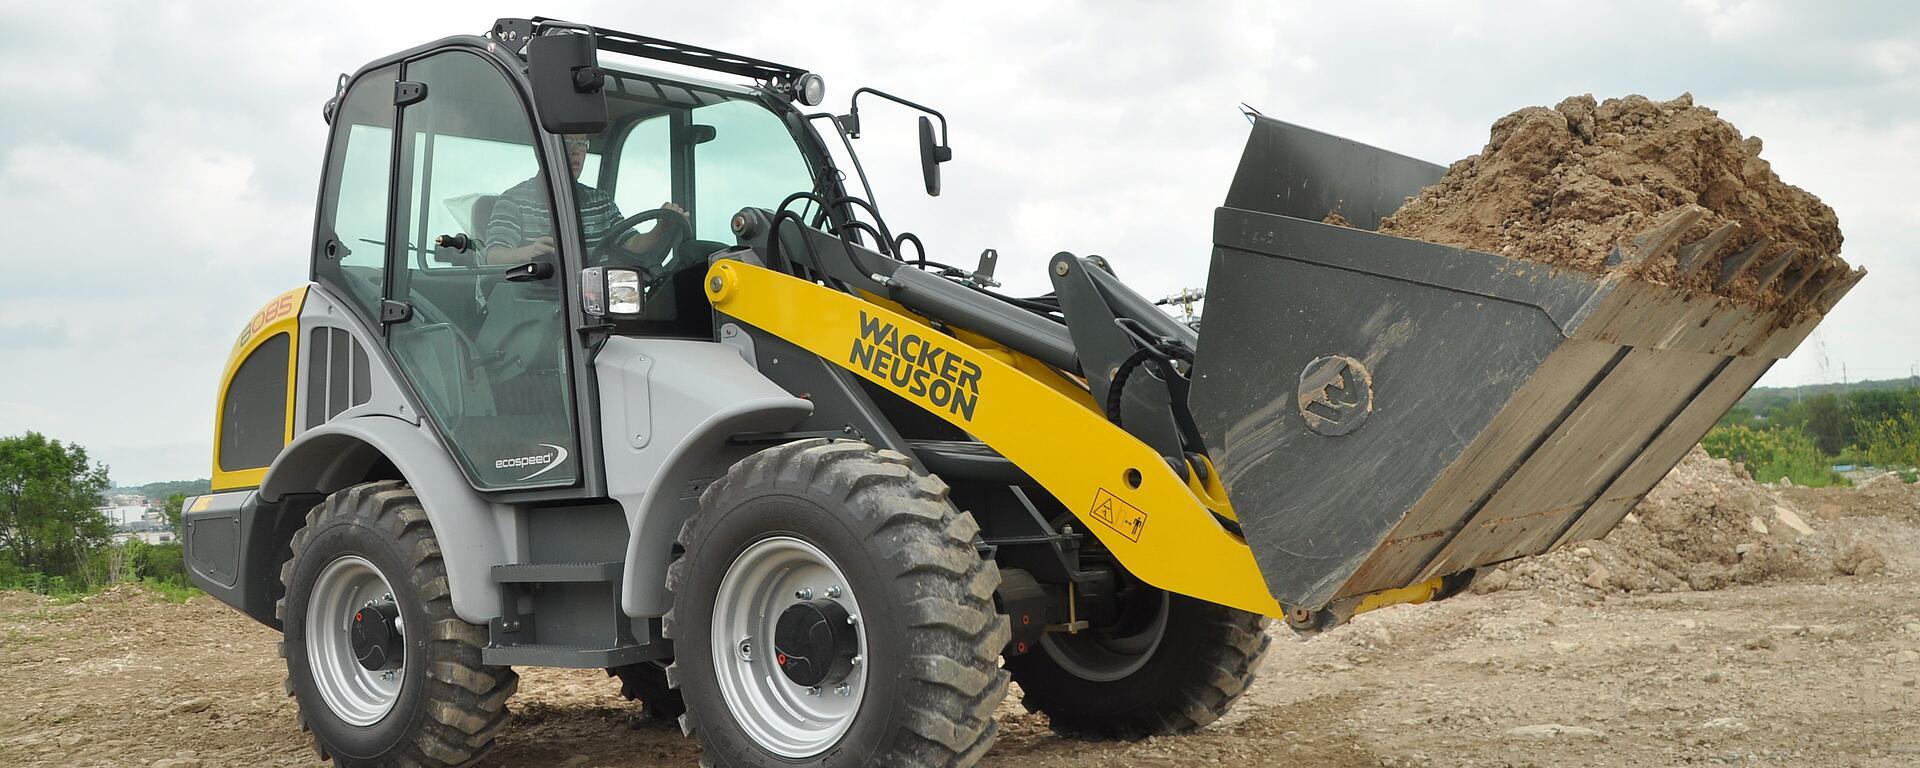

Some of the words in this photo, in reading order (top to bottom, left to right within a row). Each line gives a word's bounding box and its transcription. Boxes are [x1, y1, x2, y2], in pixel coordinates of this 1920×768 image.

[240, 294, 294, 347] 8085
[860, 310, 982, 395] WACKER
[849, 338, 978, 422] NEUSON
[495, 453, 551, 468] ecospeed
